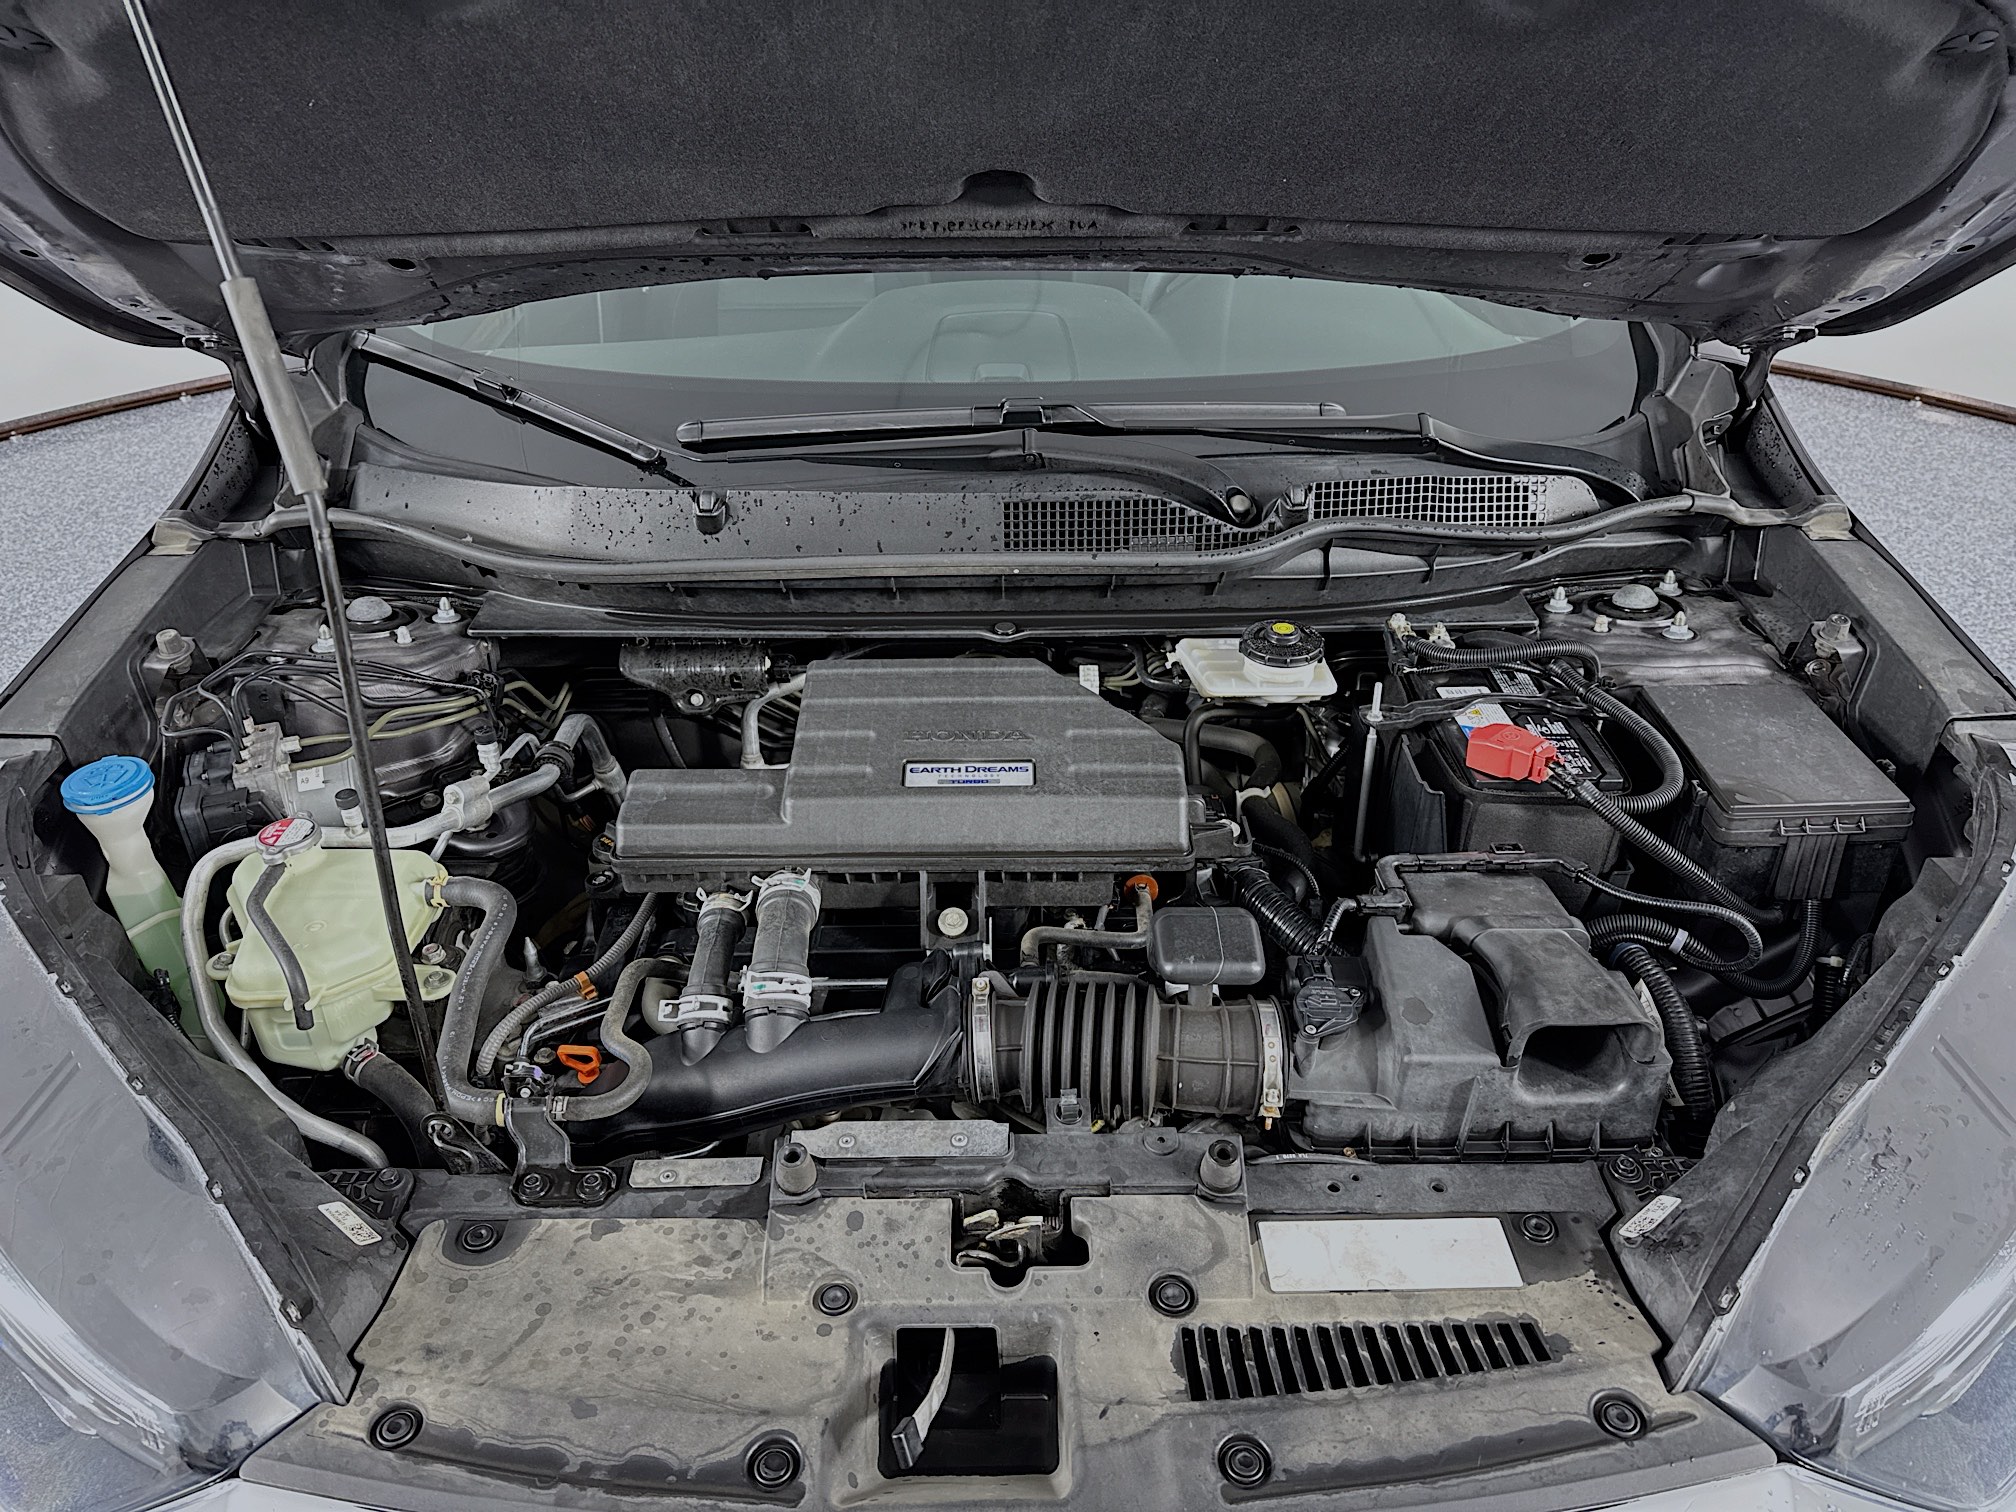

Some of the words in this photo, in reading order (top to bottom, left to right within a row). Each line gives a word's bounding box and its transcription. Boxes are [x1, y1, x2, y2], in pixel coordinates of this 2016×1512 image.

[903, 729, 1035, 742] HONDA
[909, 766, 961, 774] EARTH
[965, 765, 1029, 774] DREAMS
